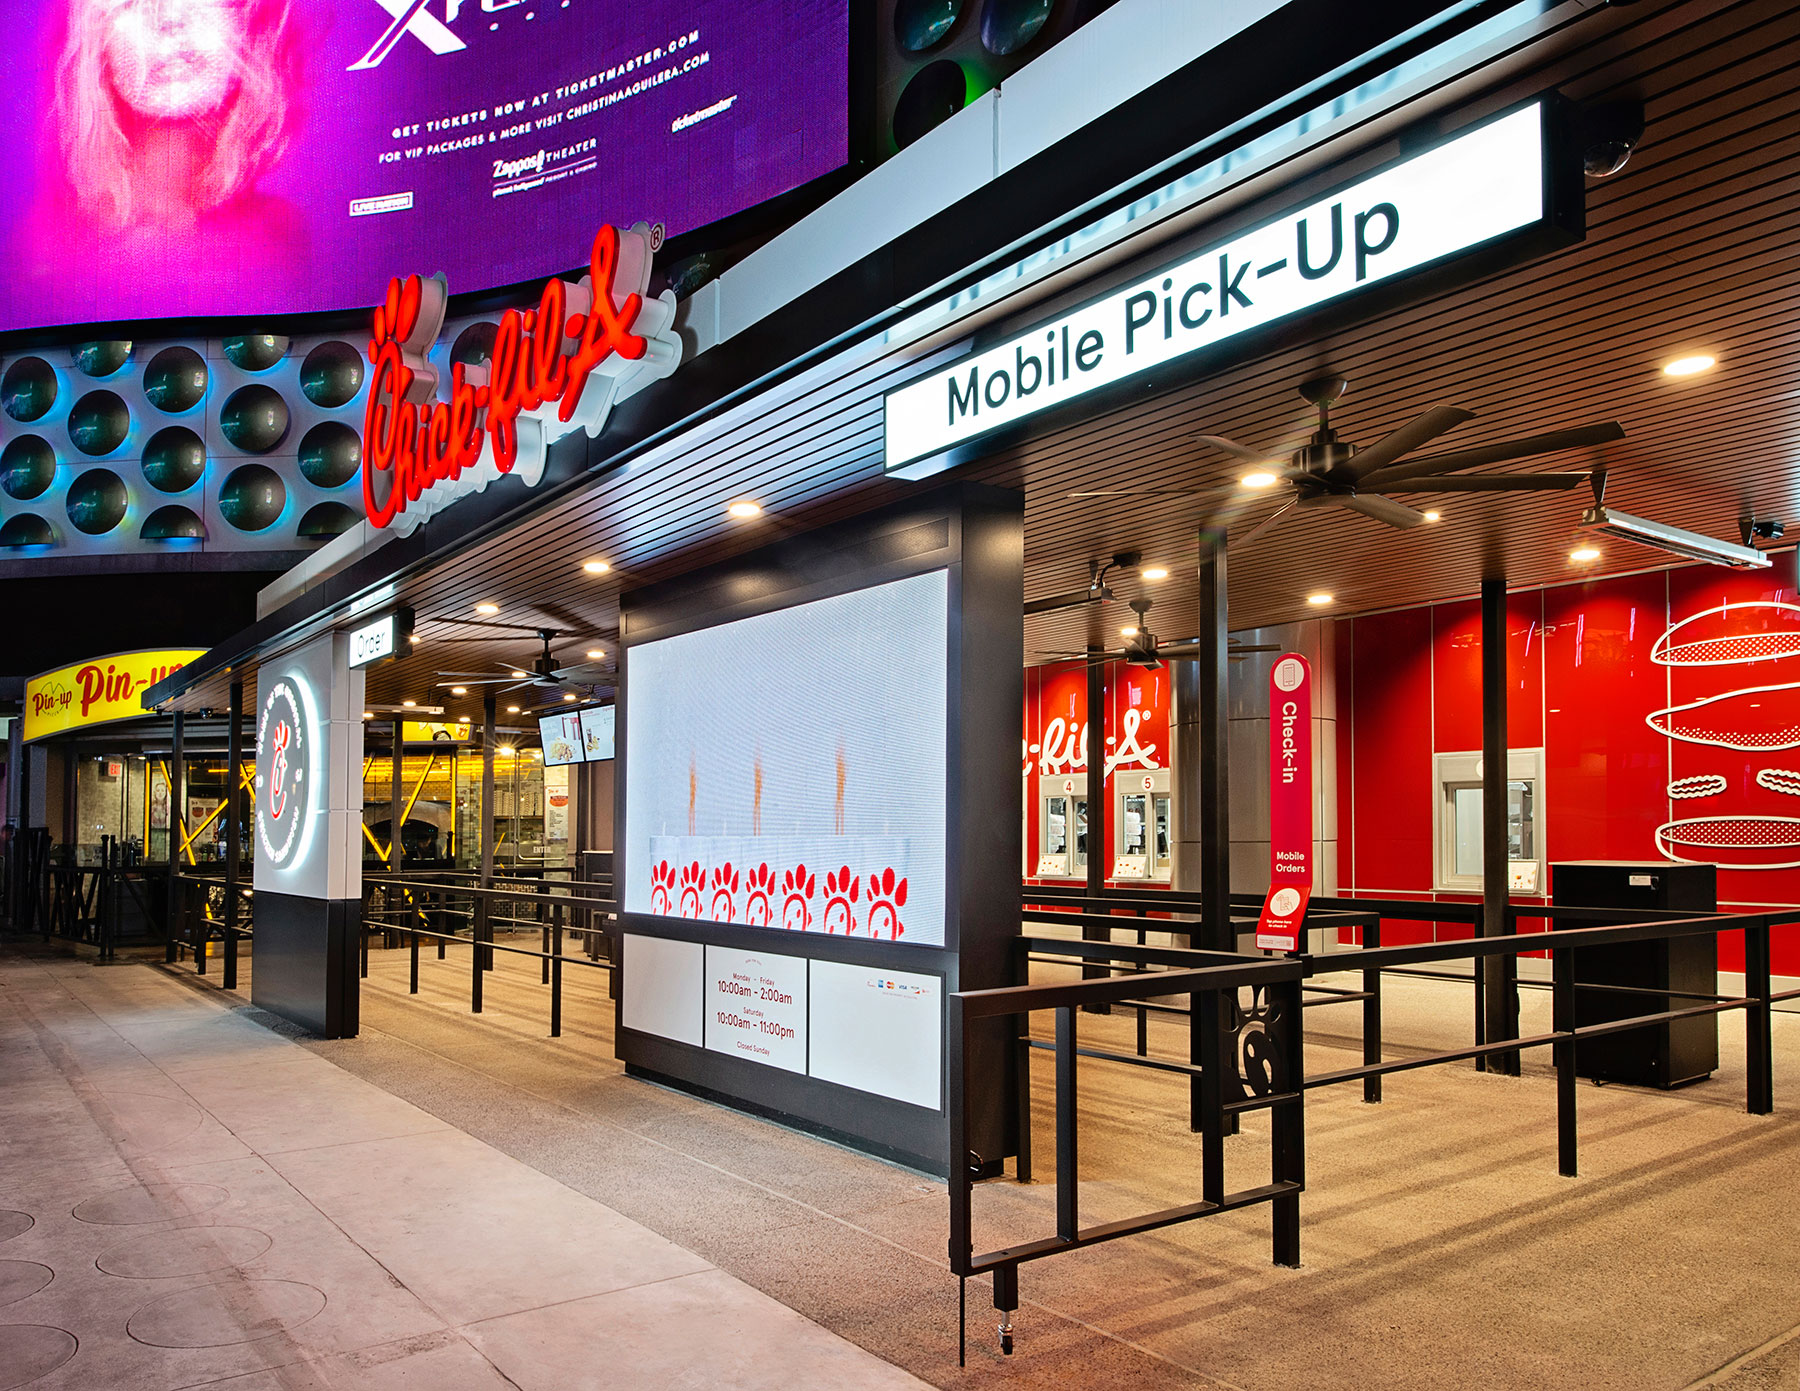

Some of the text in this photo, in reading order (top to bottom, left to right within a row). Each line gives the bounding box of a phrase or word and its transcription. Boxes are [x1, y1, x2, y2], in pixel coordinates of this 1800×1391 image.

[392, 29, 699, 139] GET TICKETS NOW AT TICKETMASTER.COM
[378, 51, 710, 164] FOR VIP PACKAGES & MORE VISIT CHRISTINAAGUILERA.COM
[545, 137, 597, 163] THEATER
[946, 199, 1400, 427] Mobile Pick-Up
[358, 630, 386, 658] Order
[32, 690, 72, 717] Pin-up
[1282, 701, 1298, 783] Check-in
[1065, 781, 1072, 792] 4
[1144, 777, 1151, 789] 5
[1275, 863, 1306, 873] Orders
[1276, 851, 1305, 861] Mobile
[732, 972, 751, 982] Monday
[759, 977, 775, 987] Friday
[718, 980, 752, 997] 10:00am
[760, 987, 793, 1005] 2:00am
[743, 1006, 764, 1018] Saturday
[717, 1011, 751, 1030] 10:00am
[759, 1020, 795, 1040] 11:00pm
[736, 1041, 770, 1056] Closed Sunday
